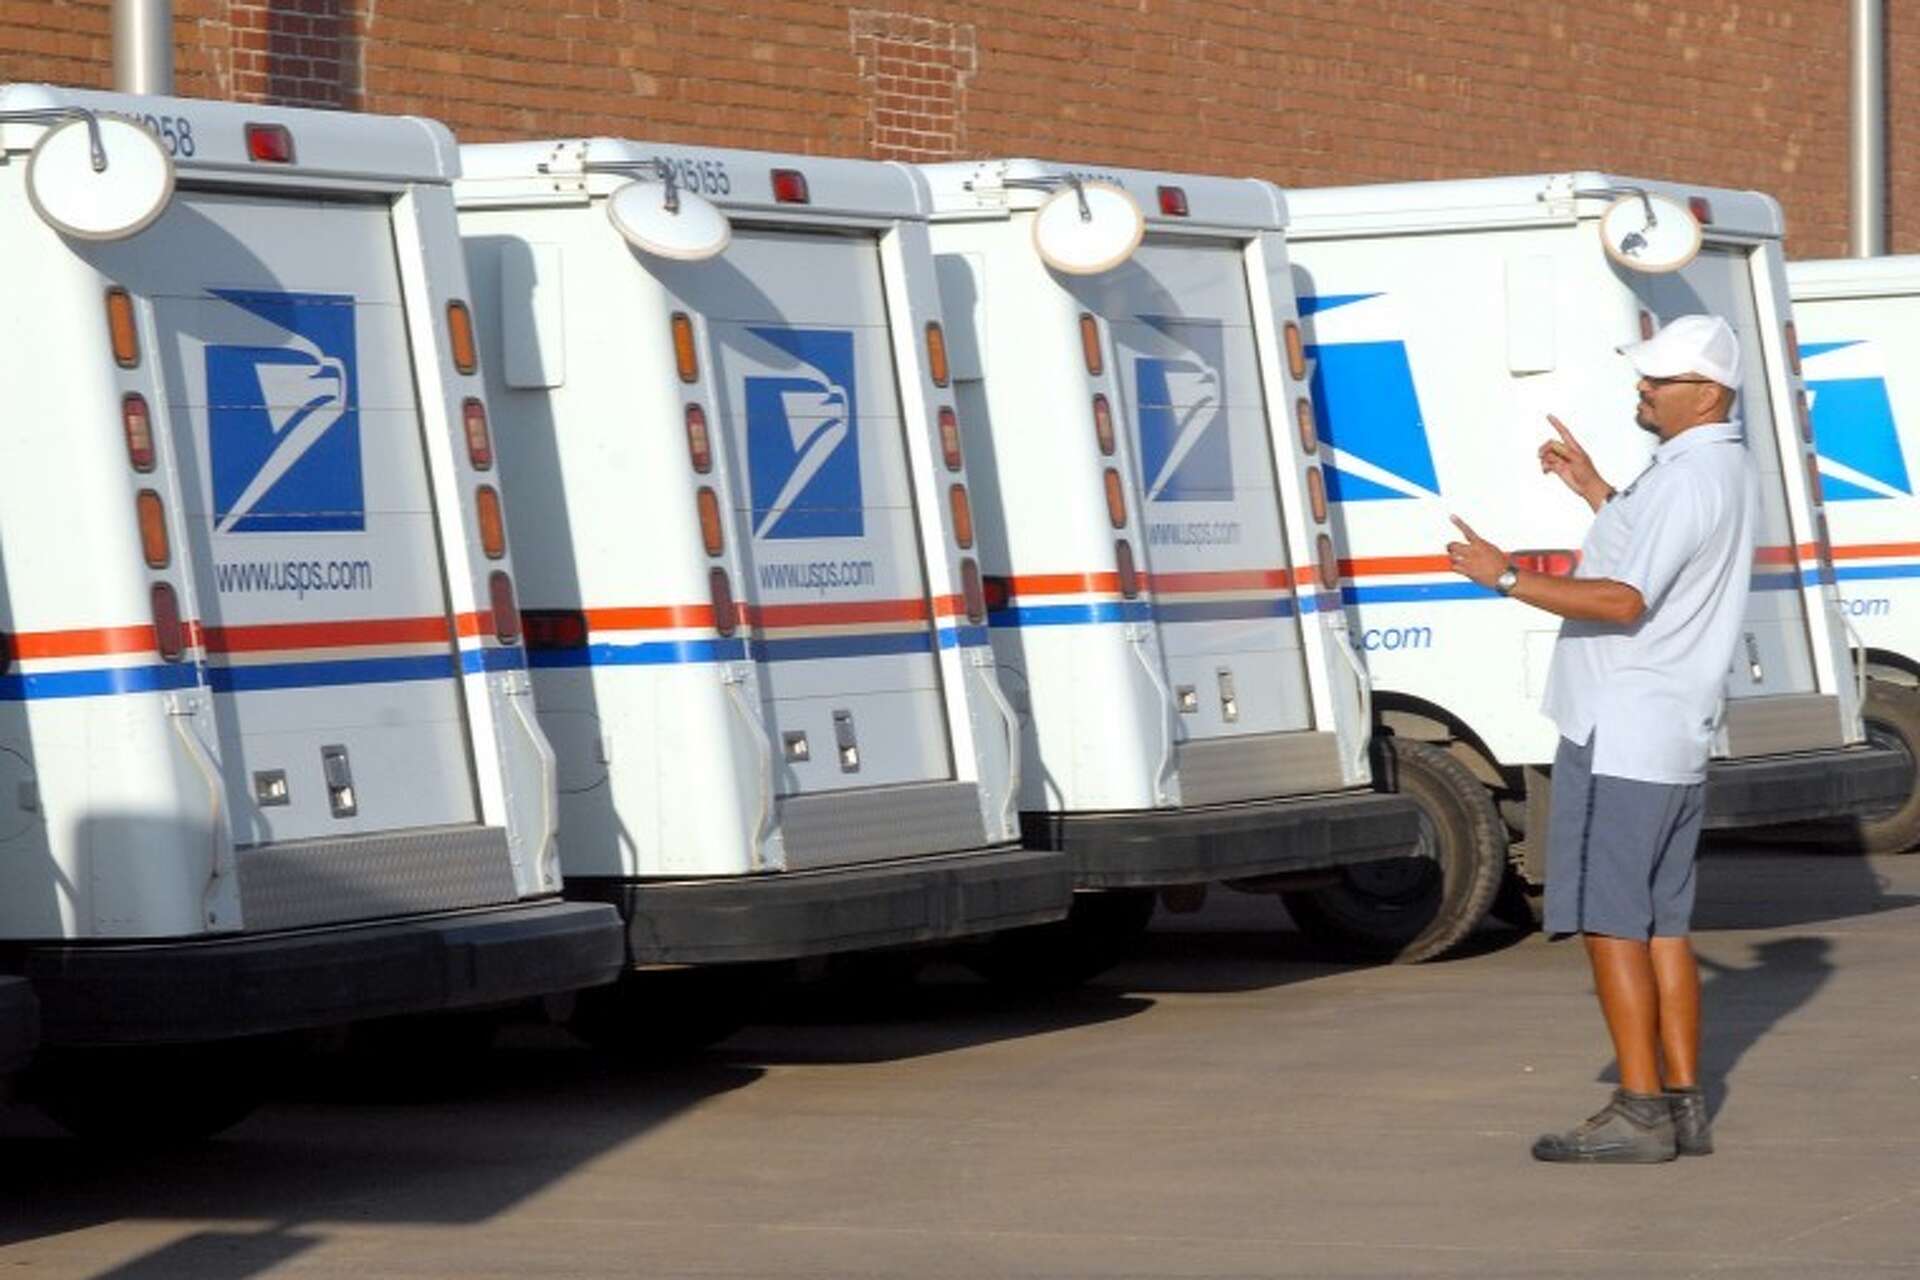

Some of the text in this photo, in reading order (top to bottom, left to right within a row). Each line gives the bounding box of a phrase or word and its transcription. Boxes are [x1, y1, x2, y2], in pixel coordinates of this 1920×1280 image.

[1146, 521, 1241, 552] www.usps.com
[216, 560, 373, 601] www.usps.com
[758, 560, 875, 597] www.usps.com
[1348, 626, 1432, 651] .com
